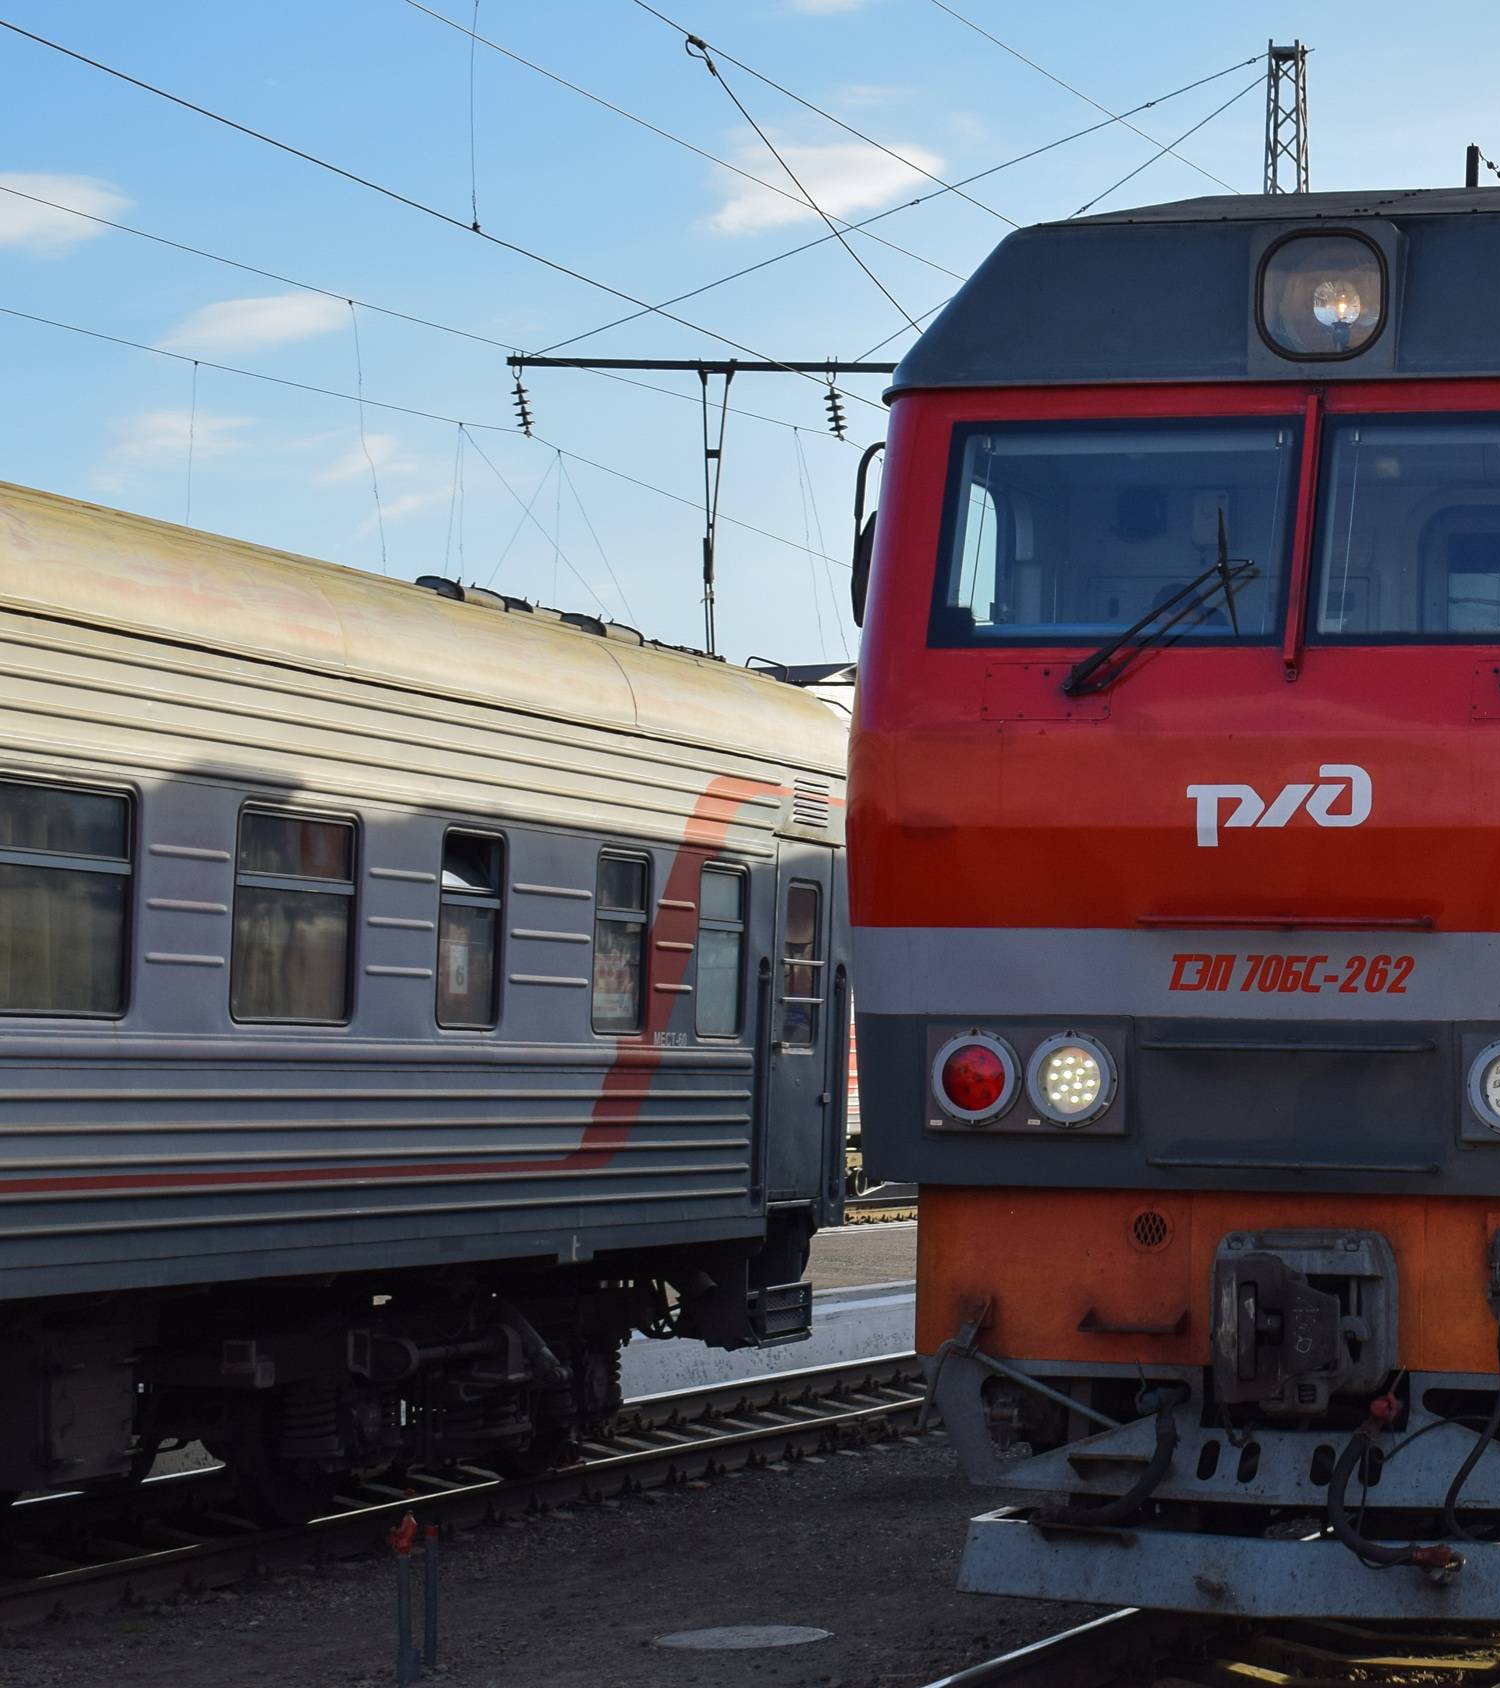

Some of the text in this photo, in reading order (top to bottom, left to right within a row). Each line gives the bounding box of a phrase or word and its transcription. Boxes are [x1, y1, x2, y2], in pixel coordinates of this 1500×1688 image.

[1186, 764, 1372, 847] РЖД
[456, 965, 464, 986] 6
[1168, 954, 1415, 993] ТЭП 70БС-262
